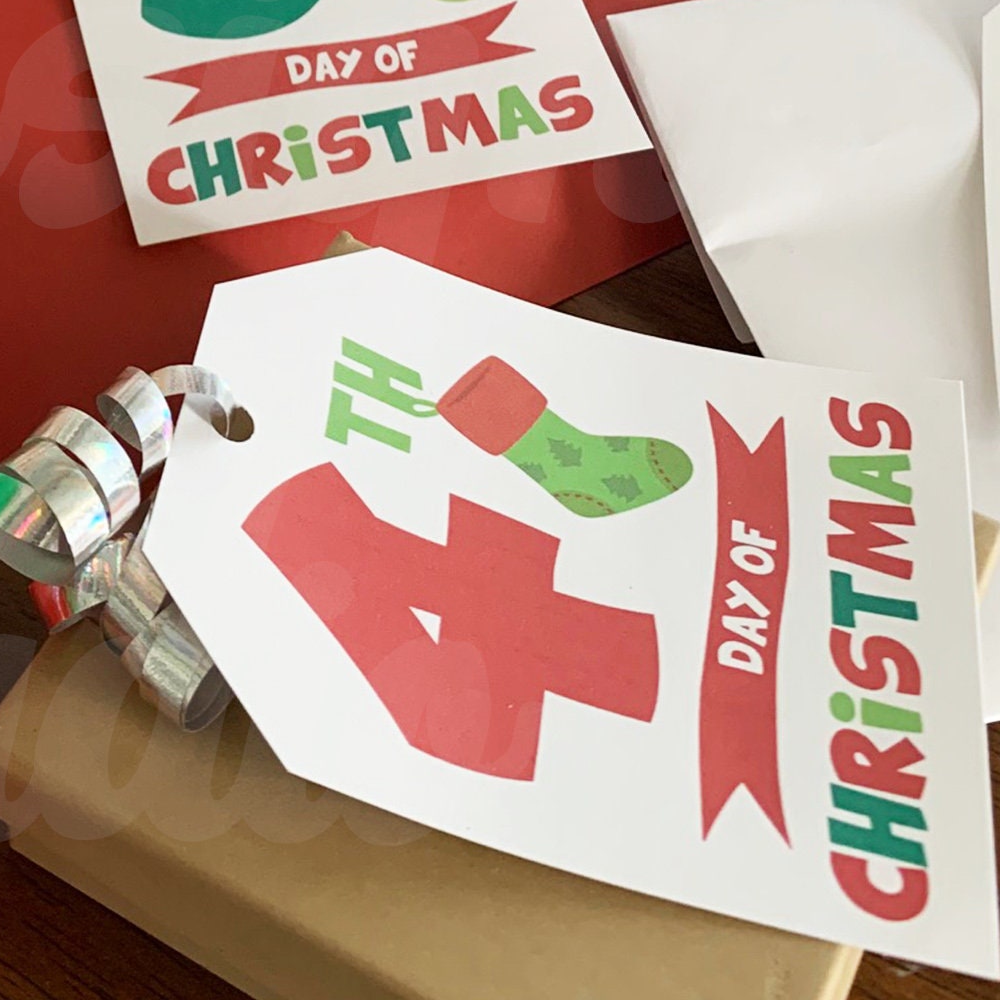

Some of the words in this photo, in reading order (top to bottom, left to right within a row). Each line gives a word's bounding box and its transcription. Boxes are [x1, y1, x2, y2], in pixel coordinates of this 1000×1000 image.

[286, 48, 363, 87] DAY
[374, 40, 418, 74] OF
[730, 520, 784, 575] OF
[718, 580, 772, 675] DAY
